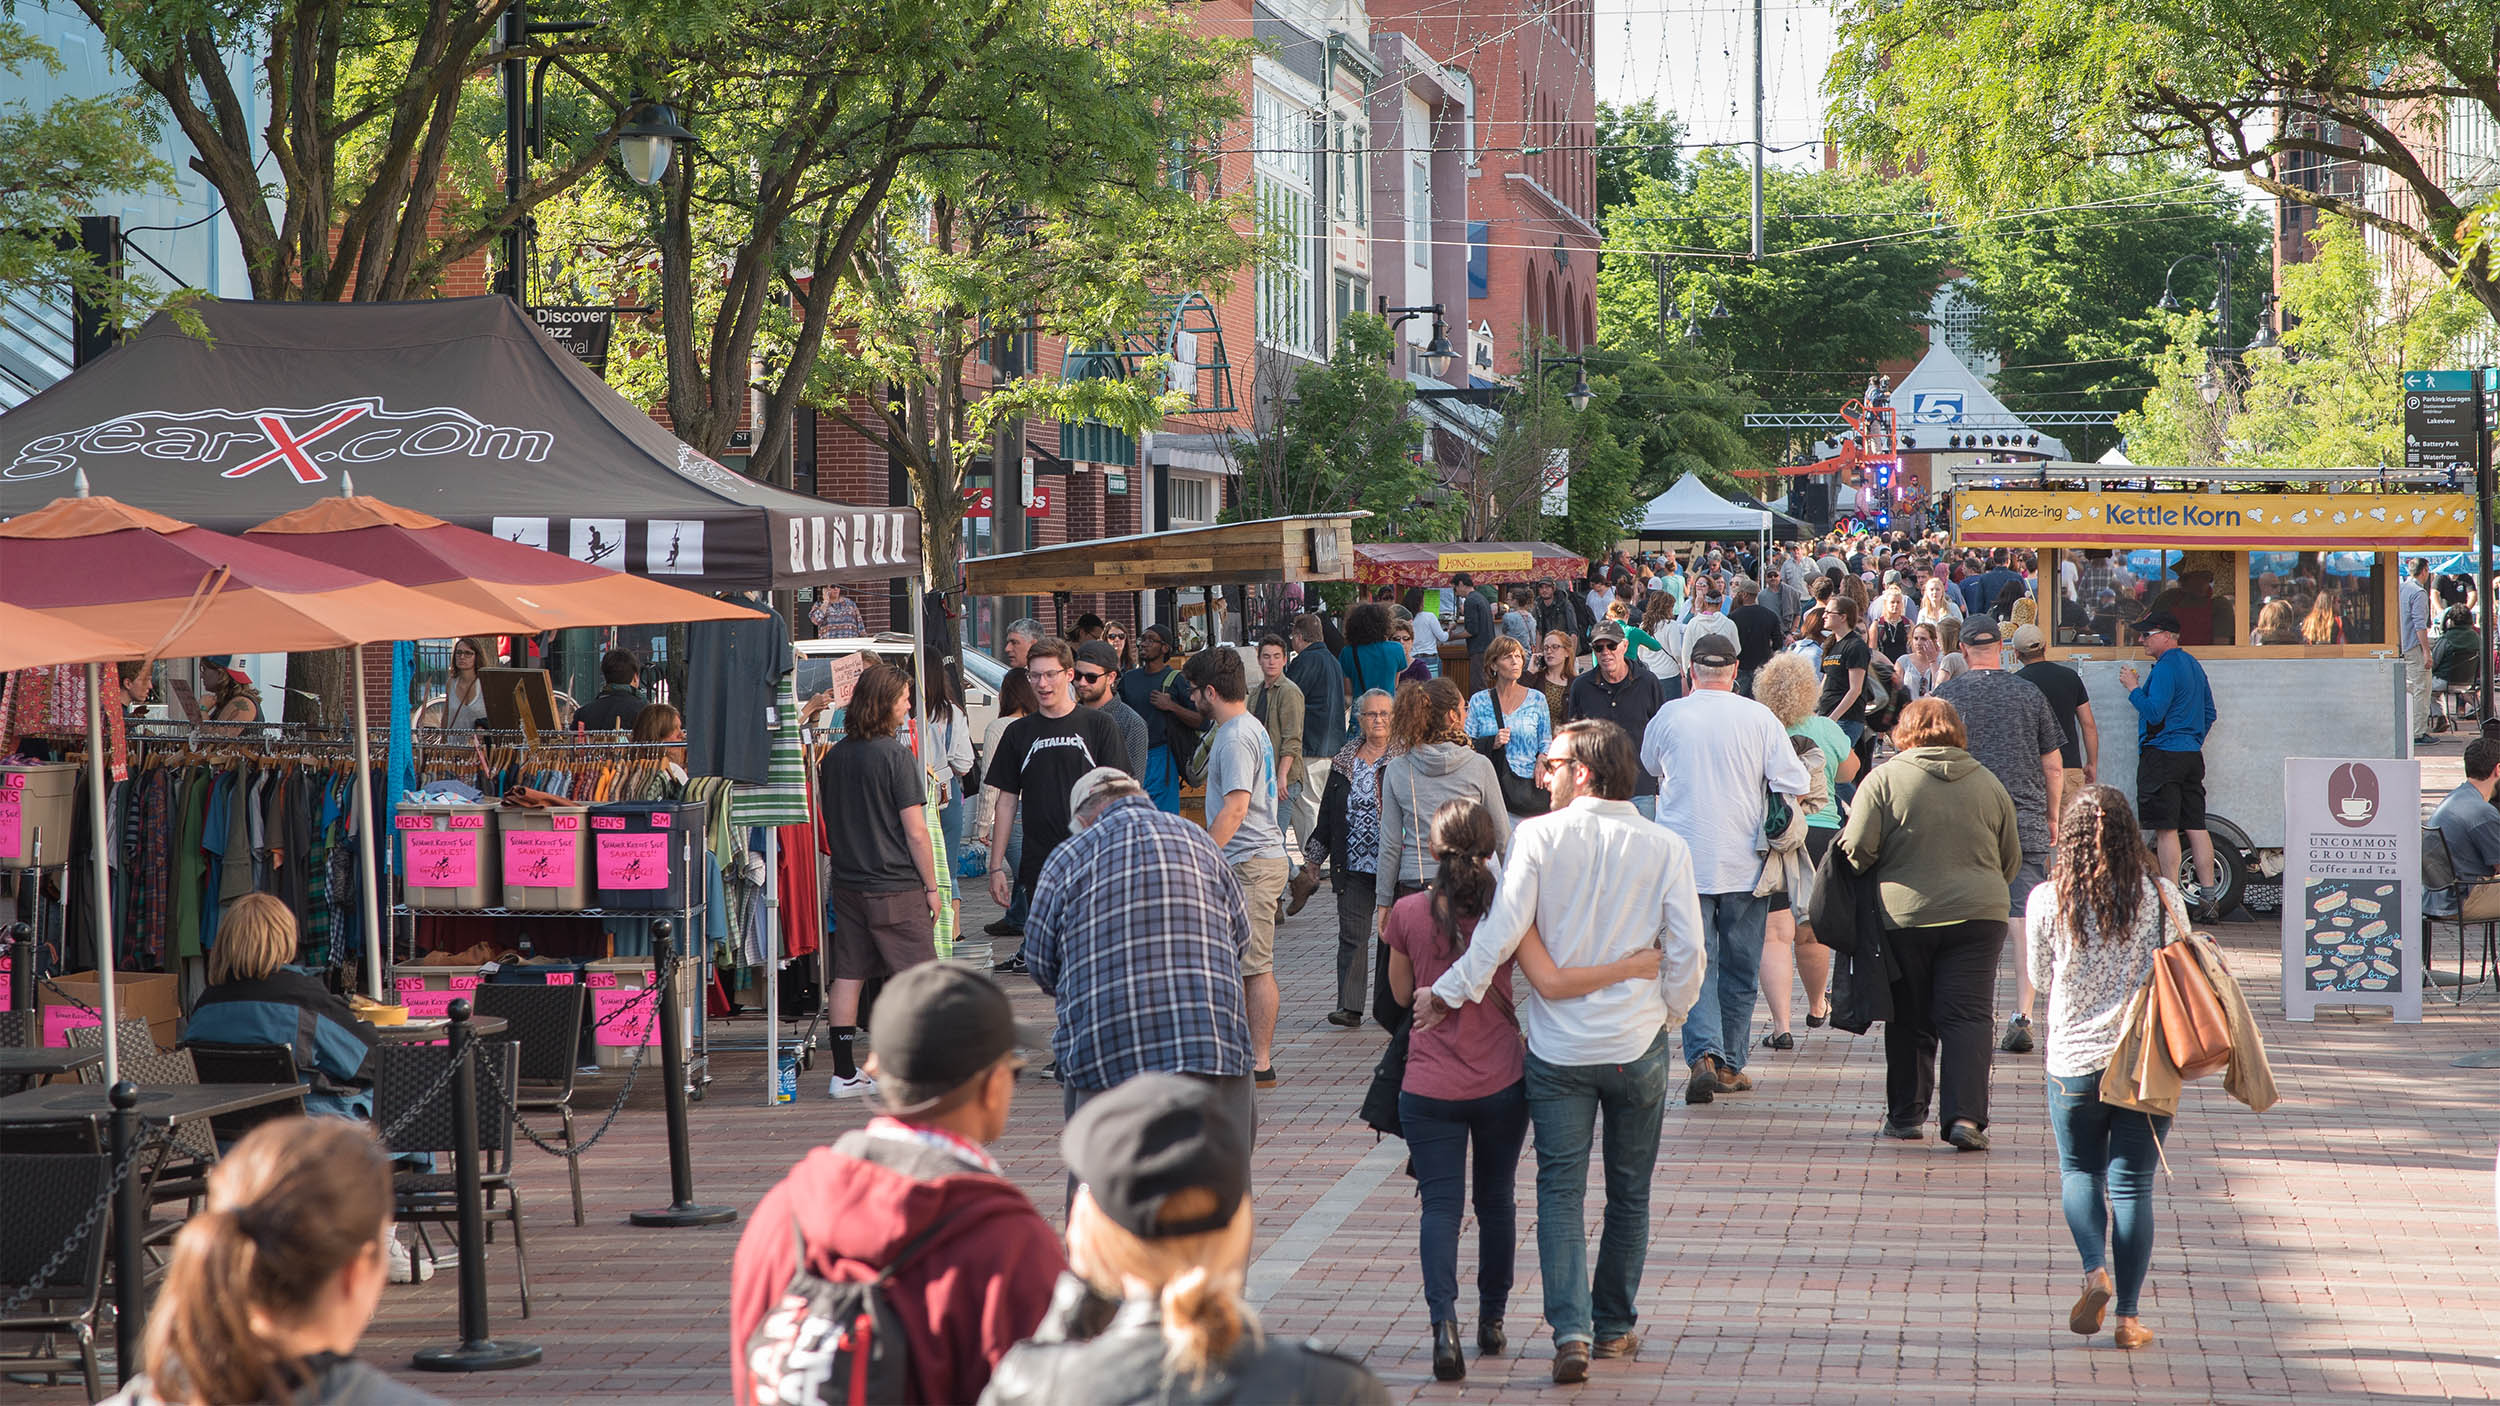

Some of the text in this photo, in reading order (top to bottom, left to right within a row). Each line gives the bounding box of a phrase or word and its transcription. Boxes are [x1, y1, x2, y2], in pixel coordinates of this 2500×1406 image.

[536, 309, 606, 323] Discover
[1916, 394, 1962, 423] 5
[736, 432, 749, 440] ST
[1984, 504, 2241, 526] A-Maize-ing Kettle Korn
[396, 816, 482, 828] MEN'S LG/XL
[554, 817, 578, 829] MD
[652, 814, 669, 826] SM
[2310, 838, 2398, 848] UNCOMMON
[2309, 850, 2398, 860] GROUNDS
[2309, 864, 2397, 874] Coffee and Tea
[2347, 932, 2400, 947] hot dogs
[396, 978, 423, 990] EN'S
[550, 974, 572, 985] MD
[2336, 980, 2360, 990] cold
[2368, 970, 2390, 980] brew
